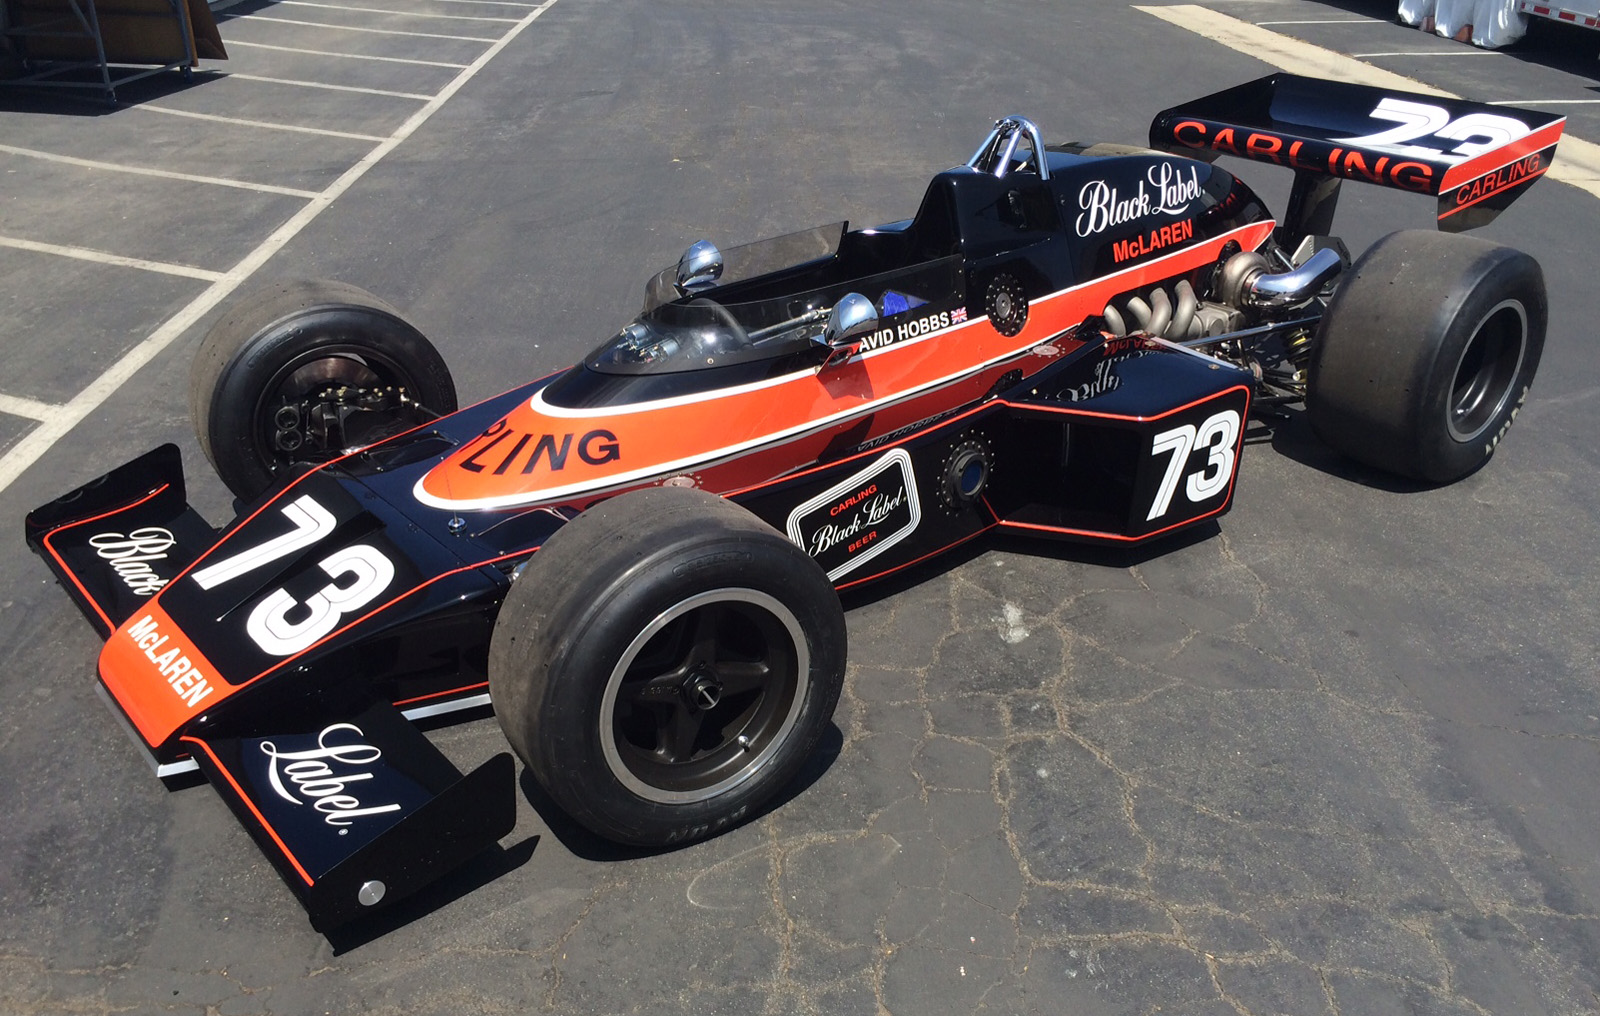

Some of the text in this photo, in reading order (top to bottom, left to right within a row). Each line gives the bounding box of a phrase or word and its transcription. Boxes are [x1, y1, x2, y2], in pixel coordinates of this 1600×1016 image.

[1173, 121, 1433, 192] CARLING
[1326, 98, 1532, 164] 73
[1456, 154, 1540, 205] CARLING
[1075, 180, 1151, 237] Black
[1113, 218, 1193, 263] McLAREN
[859, 311, 950, 352] AVID HOBBS
[459, 418, 620, 475] LING
[1146, 410, 1240, 521] 73
[830, 484, 877, 517] CARLING
[89, 527, 177, 595] Black
[808, 513, 862, 557] Black
[848, 531, 877, 553] BEER
[191, 494, 395, 656] 73
[127, 614, 214, 708] McLAREN
